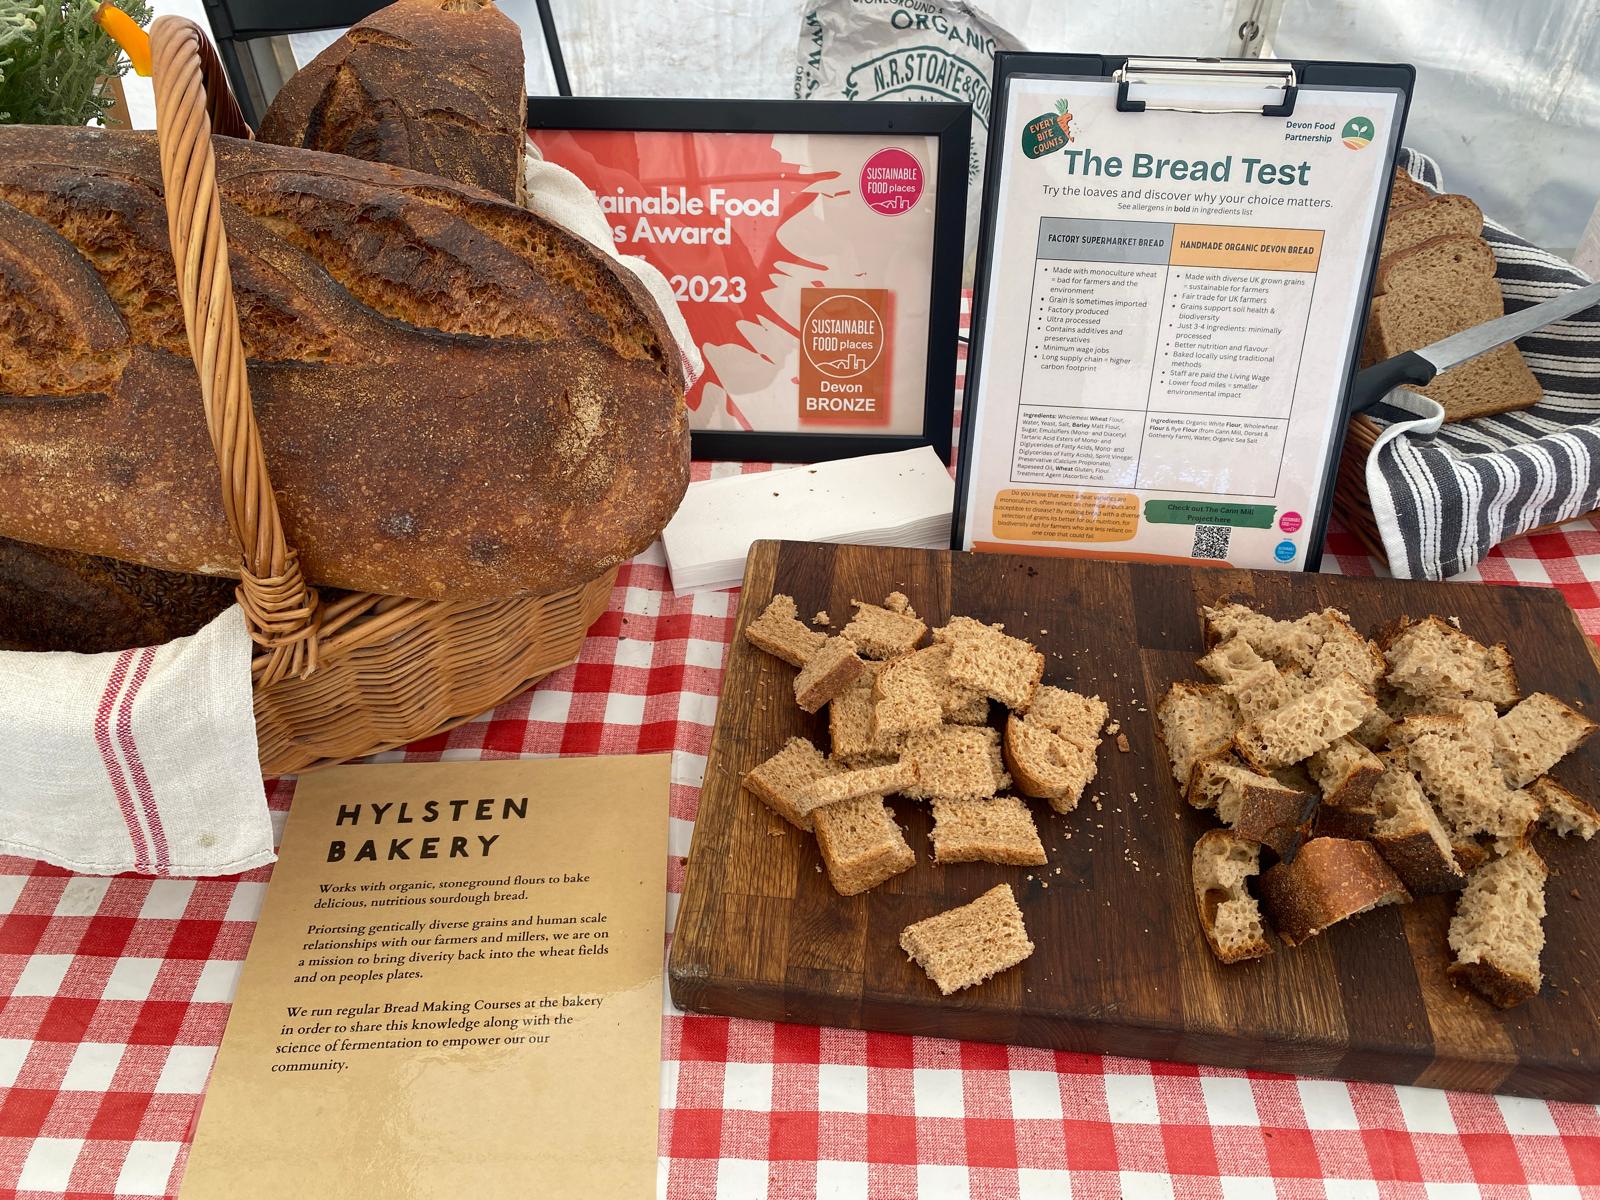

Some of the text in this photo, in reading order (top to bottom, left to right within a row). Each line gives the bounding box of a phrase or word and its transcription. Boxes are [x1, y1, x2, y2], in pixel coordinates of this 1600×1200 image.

[891, 9, 997, 60] ORGANIC
[1030, 117, 1054, 133] EVERY
[1286, 121, 1336, 130] Devon Food
[1037, 129, 1054, 142] BITE
[1285, 133, 1332, 143] Partnership
[1033, 136, 1064, 154] COUNTS
[867, 167, 917, 180] SUSTAINABLE
[1063, 148, 1311, 186] The Bread Test
[867, 182, 916, 194] FOOD places
[710, 189, 779, 216] Food
[1042, 184, 1333, 208] Try the loaves and discover why your choice matters.
[1117, 202, 1131, 210] See
[1132, 203, 1164, 212] allergens
[1173, 205, 1191, 213] bold
[1200, 207, 1241, 215] ingredients
[1242, 208, 1253, 216] list
[632, 217, 731, 245] Award
[1048, 234, 1164, 247] FACTORY SUPERMARKET BREAD
[1180, 240, 1314, 255] HANDMADE ORGANIC DEVON BREAD
[1090, 269, 1135, 277] monoculture
[1222, 275, 1248, 283] diverse
[670, 274, 747, 303] 2023
[1076, 298, 1114, 306] sometimes
[1115, 299, 1147, 308] imported
[1048, 306, 1109, 316] Factory produced
[1178, 313, 1220, 323] biodiversity
[811, 319, 875, 334] SUSTAINABLE
[1045, 325, 1076, 333] Contains
[1077, 327, 1108, 335] additives
[812, 336, 873, 351] FOOD places
[1043, 344, 1075, 352] Minimum
[1174, 341, 1196, 349] Better
[1195, 352, 1218, 361] locally
[1219, 354, 1238, 362] using
[1239, 355, 1275, 363] traditional
[820, 381, 863, 393] Devon
[806, 397, 876, 411] BRONZE
[1188, 515, 1212, 523] Project
[335, 797, 529, 826] HYLSTEN
[326, 834, 500, 863] BAKERY
[319, 882, 356, 893] Works
[360, 881, 386, 892] with
[389, 880, 435, 893] organic,
[439, 876, 511, 890] stoneground
[514, 875, 545, 885] flours
[563, 873, 590, 883] bake
[314, 890, 528, 909] delicious, nutritious sourdough bread.
[307, 912, 607, 936] Priortsing gentically diverse grains and human scale
[302, 938, 377, 951] relationships
[381, 936, 407, 947] with
[434, 934, 478, 945] farmers
[481, 932, 503, 943] and
[506, 931, 548, 942] millers,
[308, 956, 354, 966] mission
[373, 953, 406, 966] bring
[408, 951, 455, 964] diverity
[458, 949, 485, 960] back
[489, 949, 514, 959] into
[517, 947, 536, 958] the
[539, 946, 575, 957] wheat
[578, 944, 609, 955] fields
[294, 971, 318, 983] and
[338, 970, 383, 985] peoples
[386, 968, 423, 983] plates.
[287, 1007, 308, 1017] We
[336, 1003, 380, 1019] regular
[383, 1001, 419, 1013] Bread
[422, 1000, 471, 1014] Making
[474, 1000, 521, 1010] Courses
[524, 1000, 536, 1008] at
[540, 996, 558, 1008] the
[562, 995, 603, 1009] bakery
[280, 1013, 573, 1035] in order to share this knowledge along with the
[276, 1042, 321, 1054] science
[324, 1039, 340, 1052] of
[339, 1037, 422, 1051] fermentation
[426, 1039, 439, 1047] to
[442, 1037, 501, 1050] empower
[504, 1036, 525, 1045] our
[271, 1059, 348, 1074] community.
